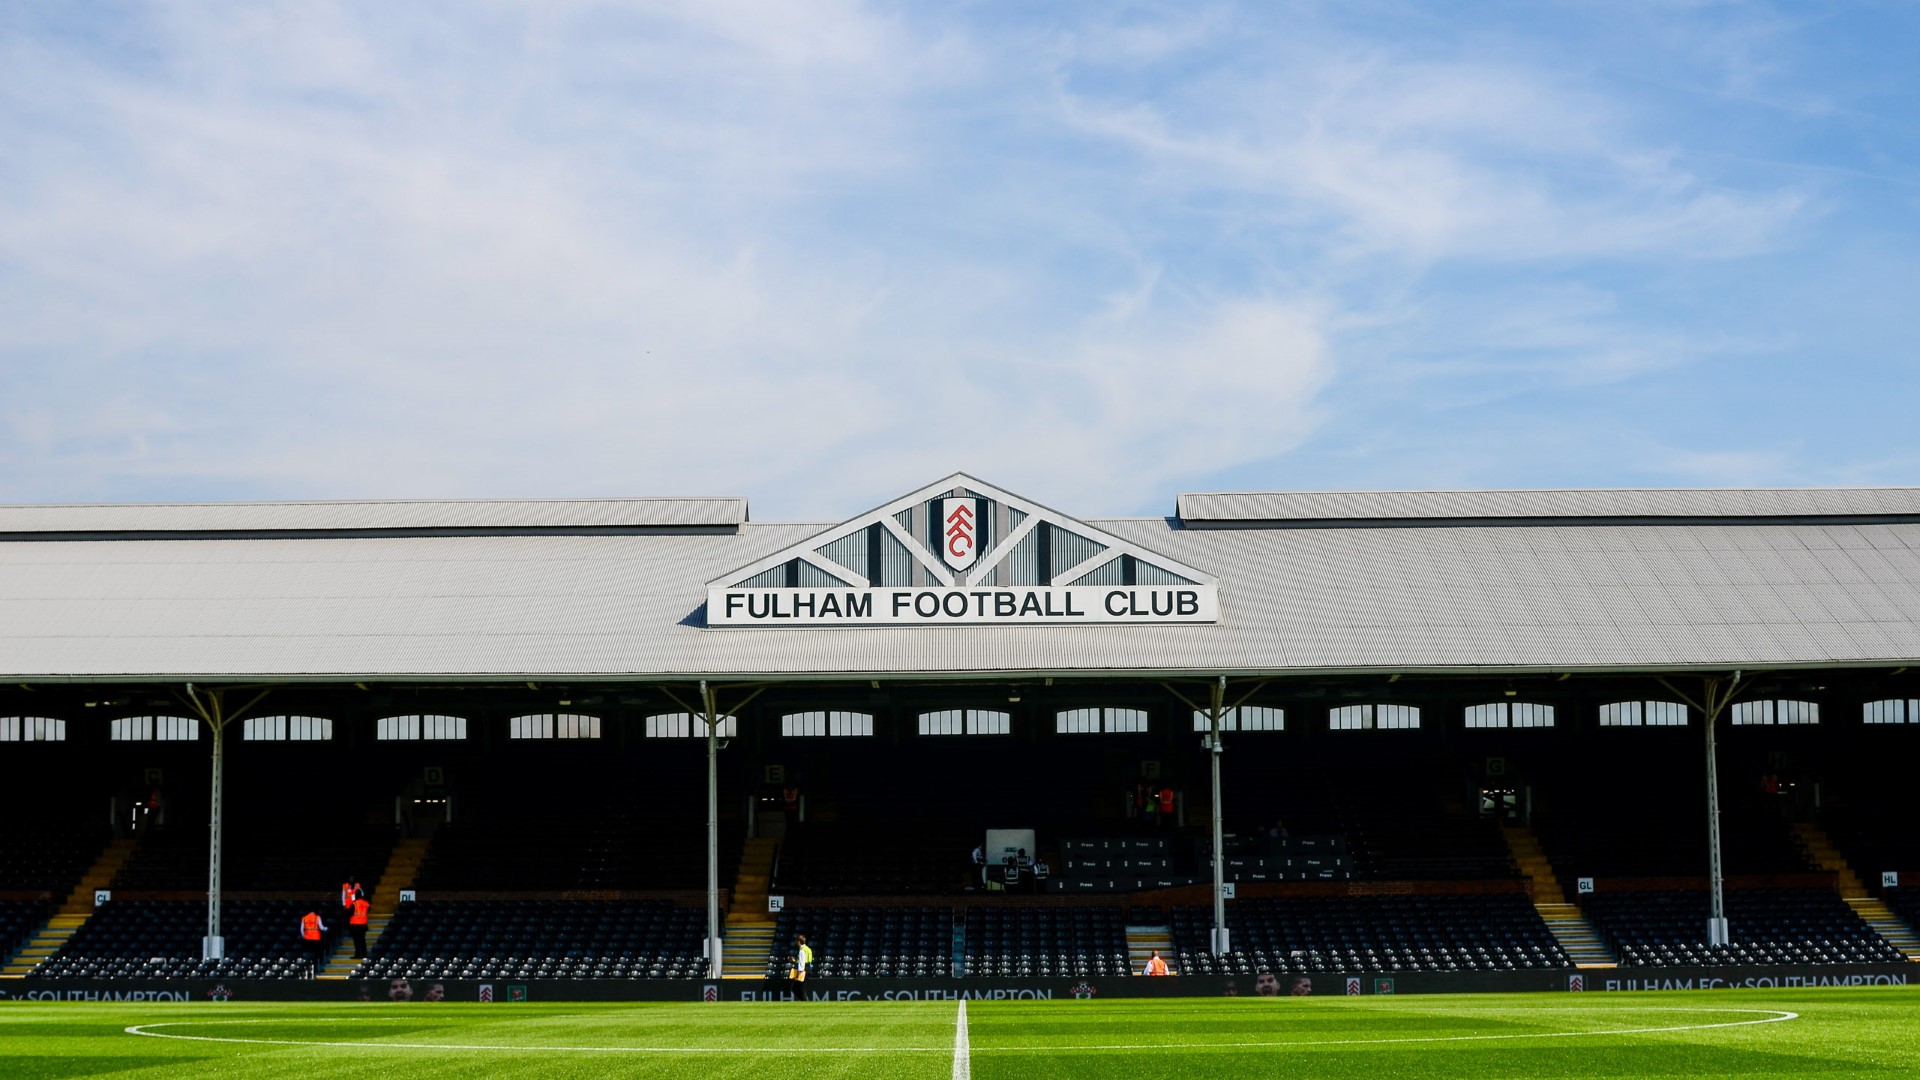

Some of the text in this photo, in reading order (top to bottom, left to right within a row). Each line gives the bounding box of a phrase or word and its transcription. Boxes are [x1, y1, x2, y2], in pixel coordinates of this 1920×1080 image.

[725, 590, 1200, 618] FULHAM FOOTBALL CLUB
[1579, 881, 1592, 890] GL
[1884, 876, 1896, 884] HL
[770, 899, 782, 908] EL
[1745, 974, 1907, 988] SOUTHAMPTON
[27, 990, 190, 1002] SOUTHAMPTON
[883, 989, 1052, 1001] SOUTHAMPTON
